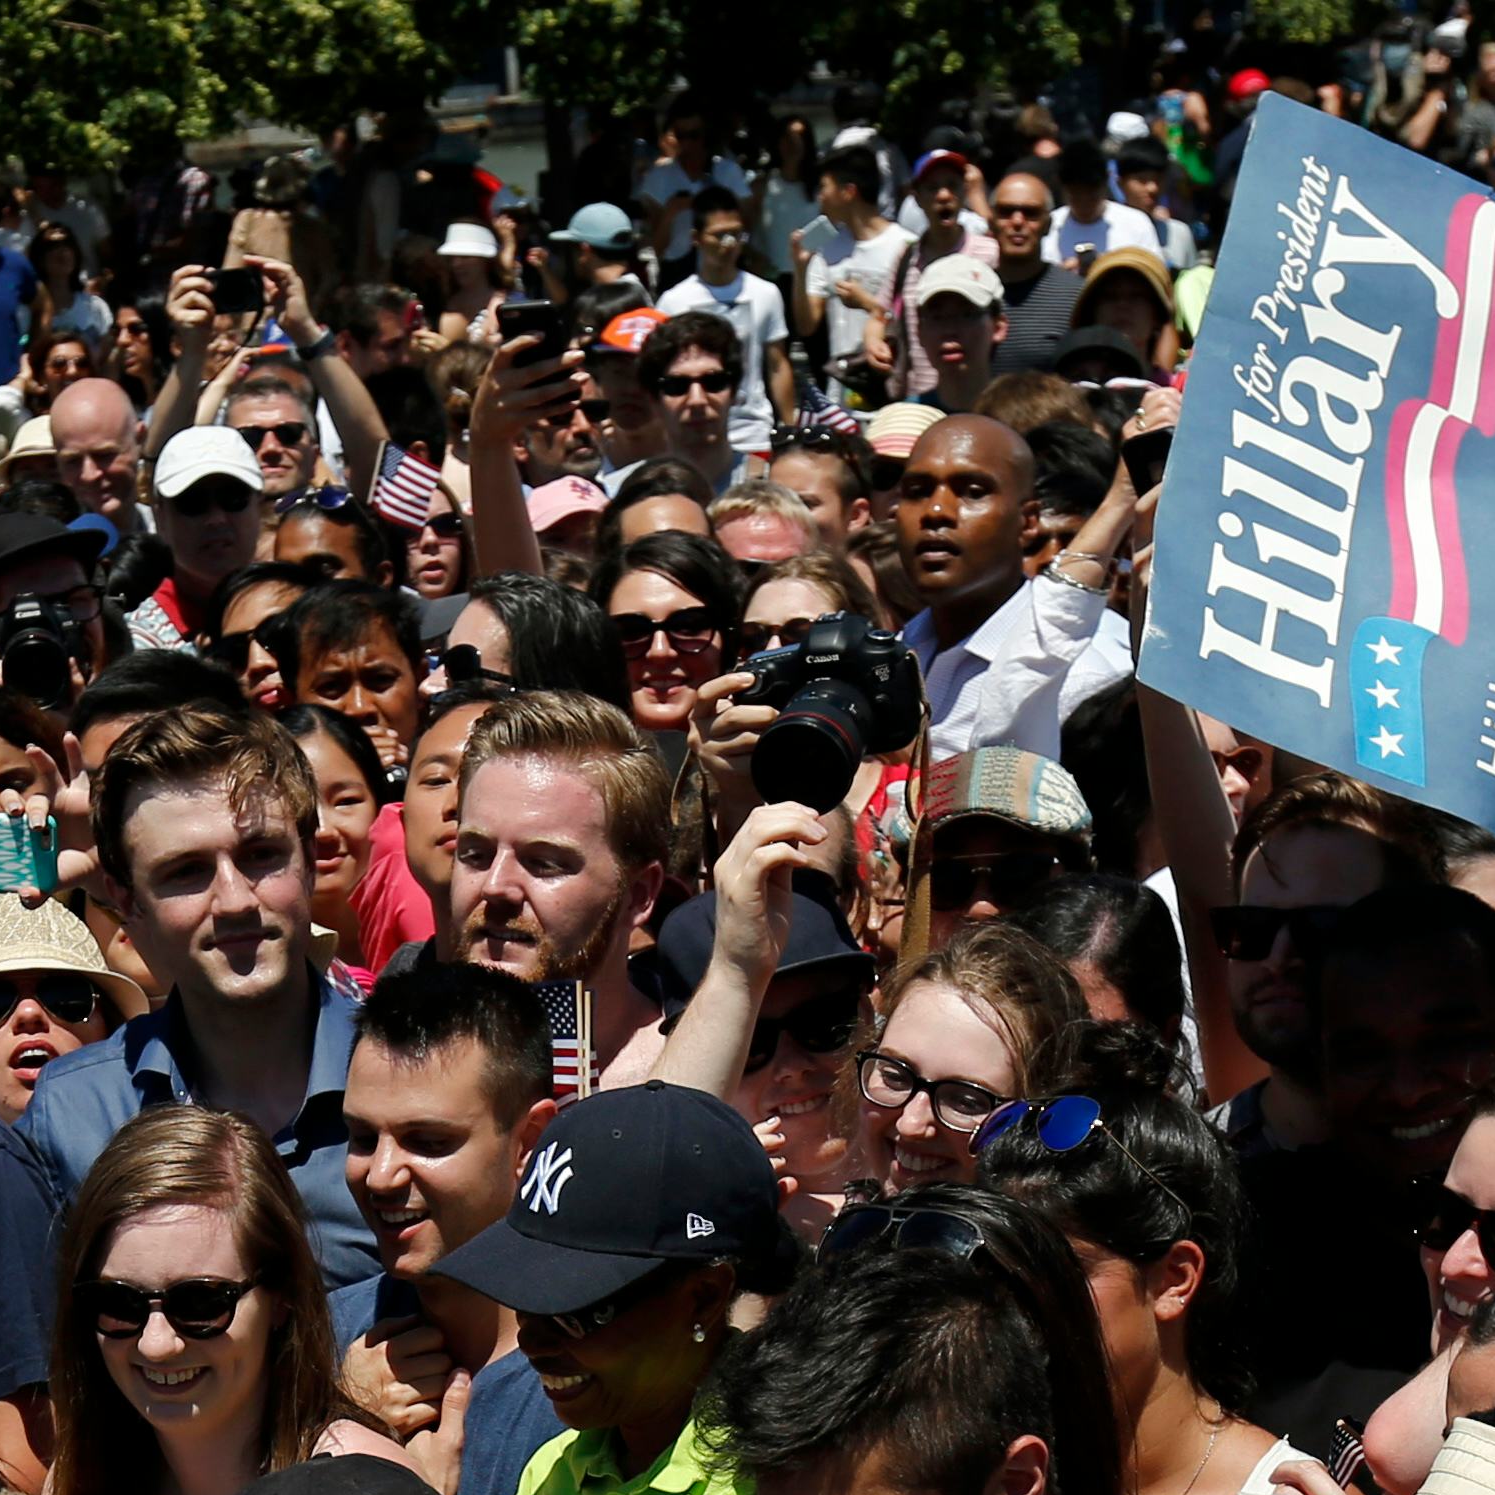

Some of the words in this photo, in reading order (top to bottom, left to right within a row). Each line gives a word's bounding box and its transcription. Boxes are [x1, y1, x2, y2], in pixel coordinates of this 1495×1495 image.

[1250, 155, 1332, 345] President
[1233, 343, 1280, 424] for
[1199, 175, 1459, 708] Hillary
[806, 653, 840, 664] Canon
[520, 1140, 575, 1216] NY
